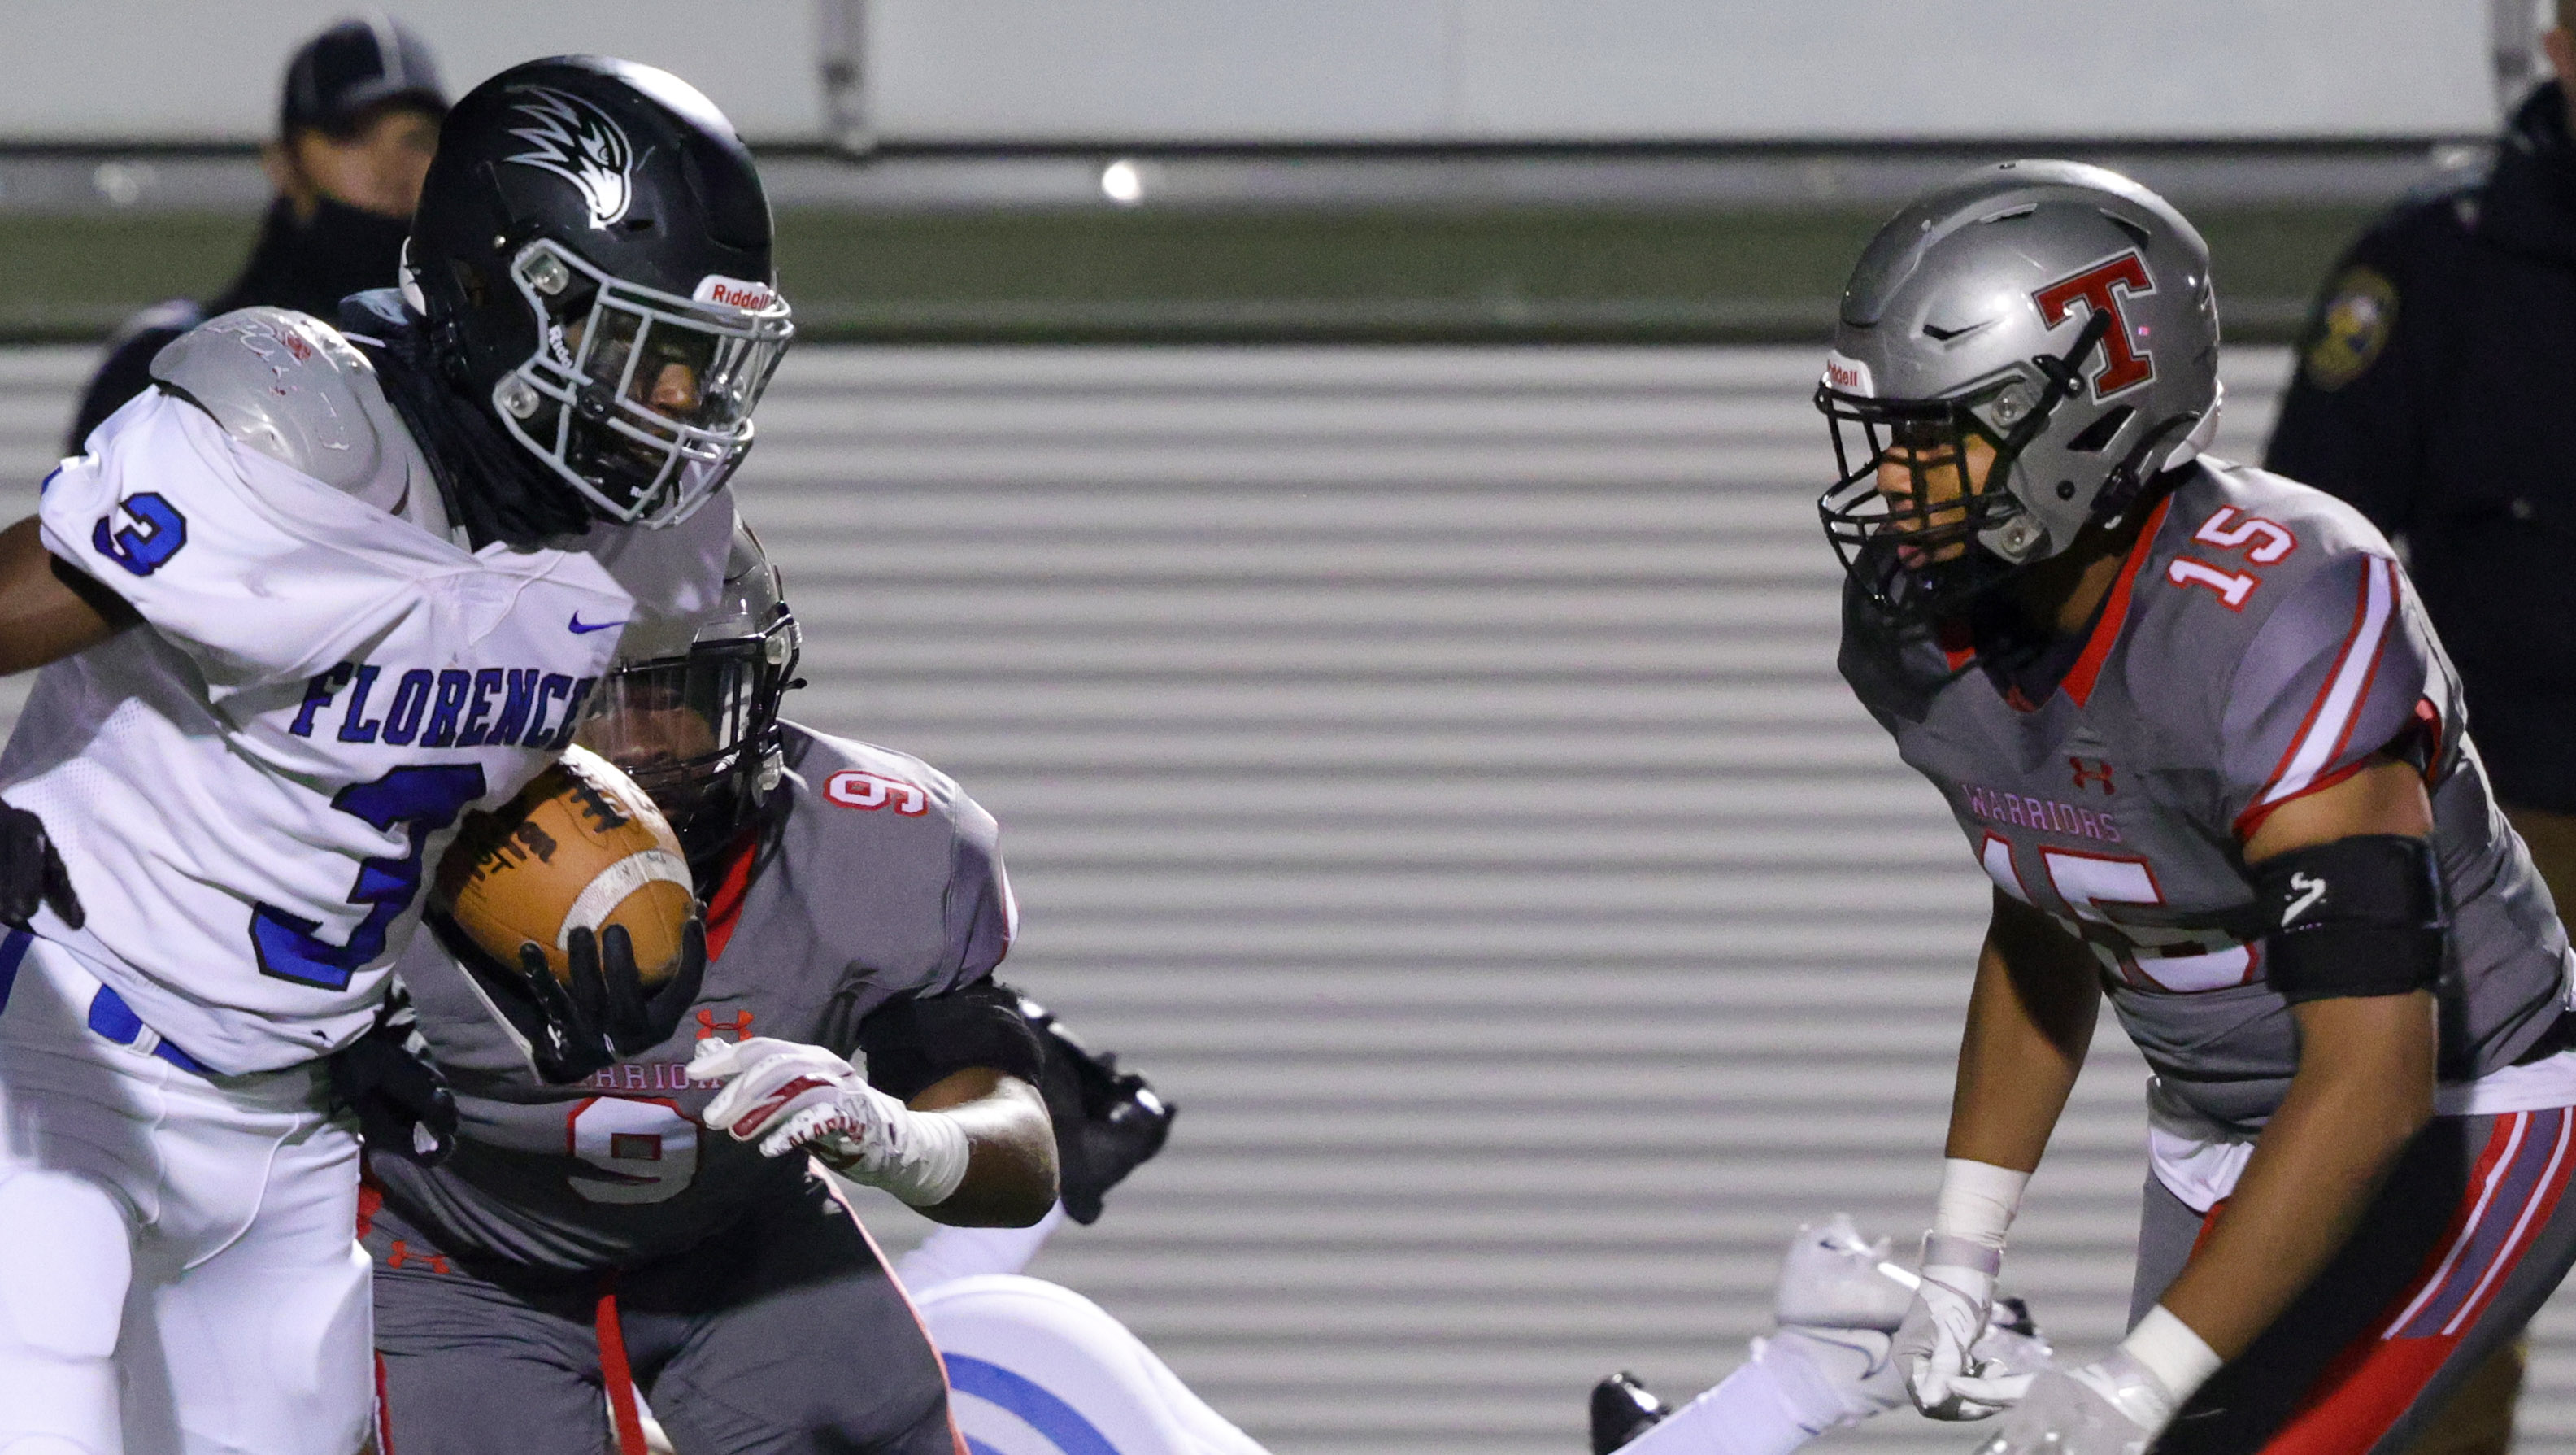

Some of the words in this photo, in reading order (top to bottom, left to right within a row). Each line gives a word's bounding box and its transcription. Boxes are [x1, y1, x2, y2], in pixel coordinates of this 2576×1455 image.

[712, 284, 769, 311] Riddell
[2030, 246, 2158, 406] T
[92, 492, 187, 578] 3
[2166, 504, 2299, 613] 15
[823, 769, 929, 817] 9
[1960, 781, 2124, 843] WARRIORS
[248, 762, 487, 992] 3
[1979, 828, 2260, 995] 15
[566, 1095, 699, 1205] 9
